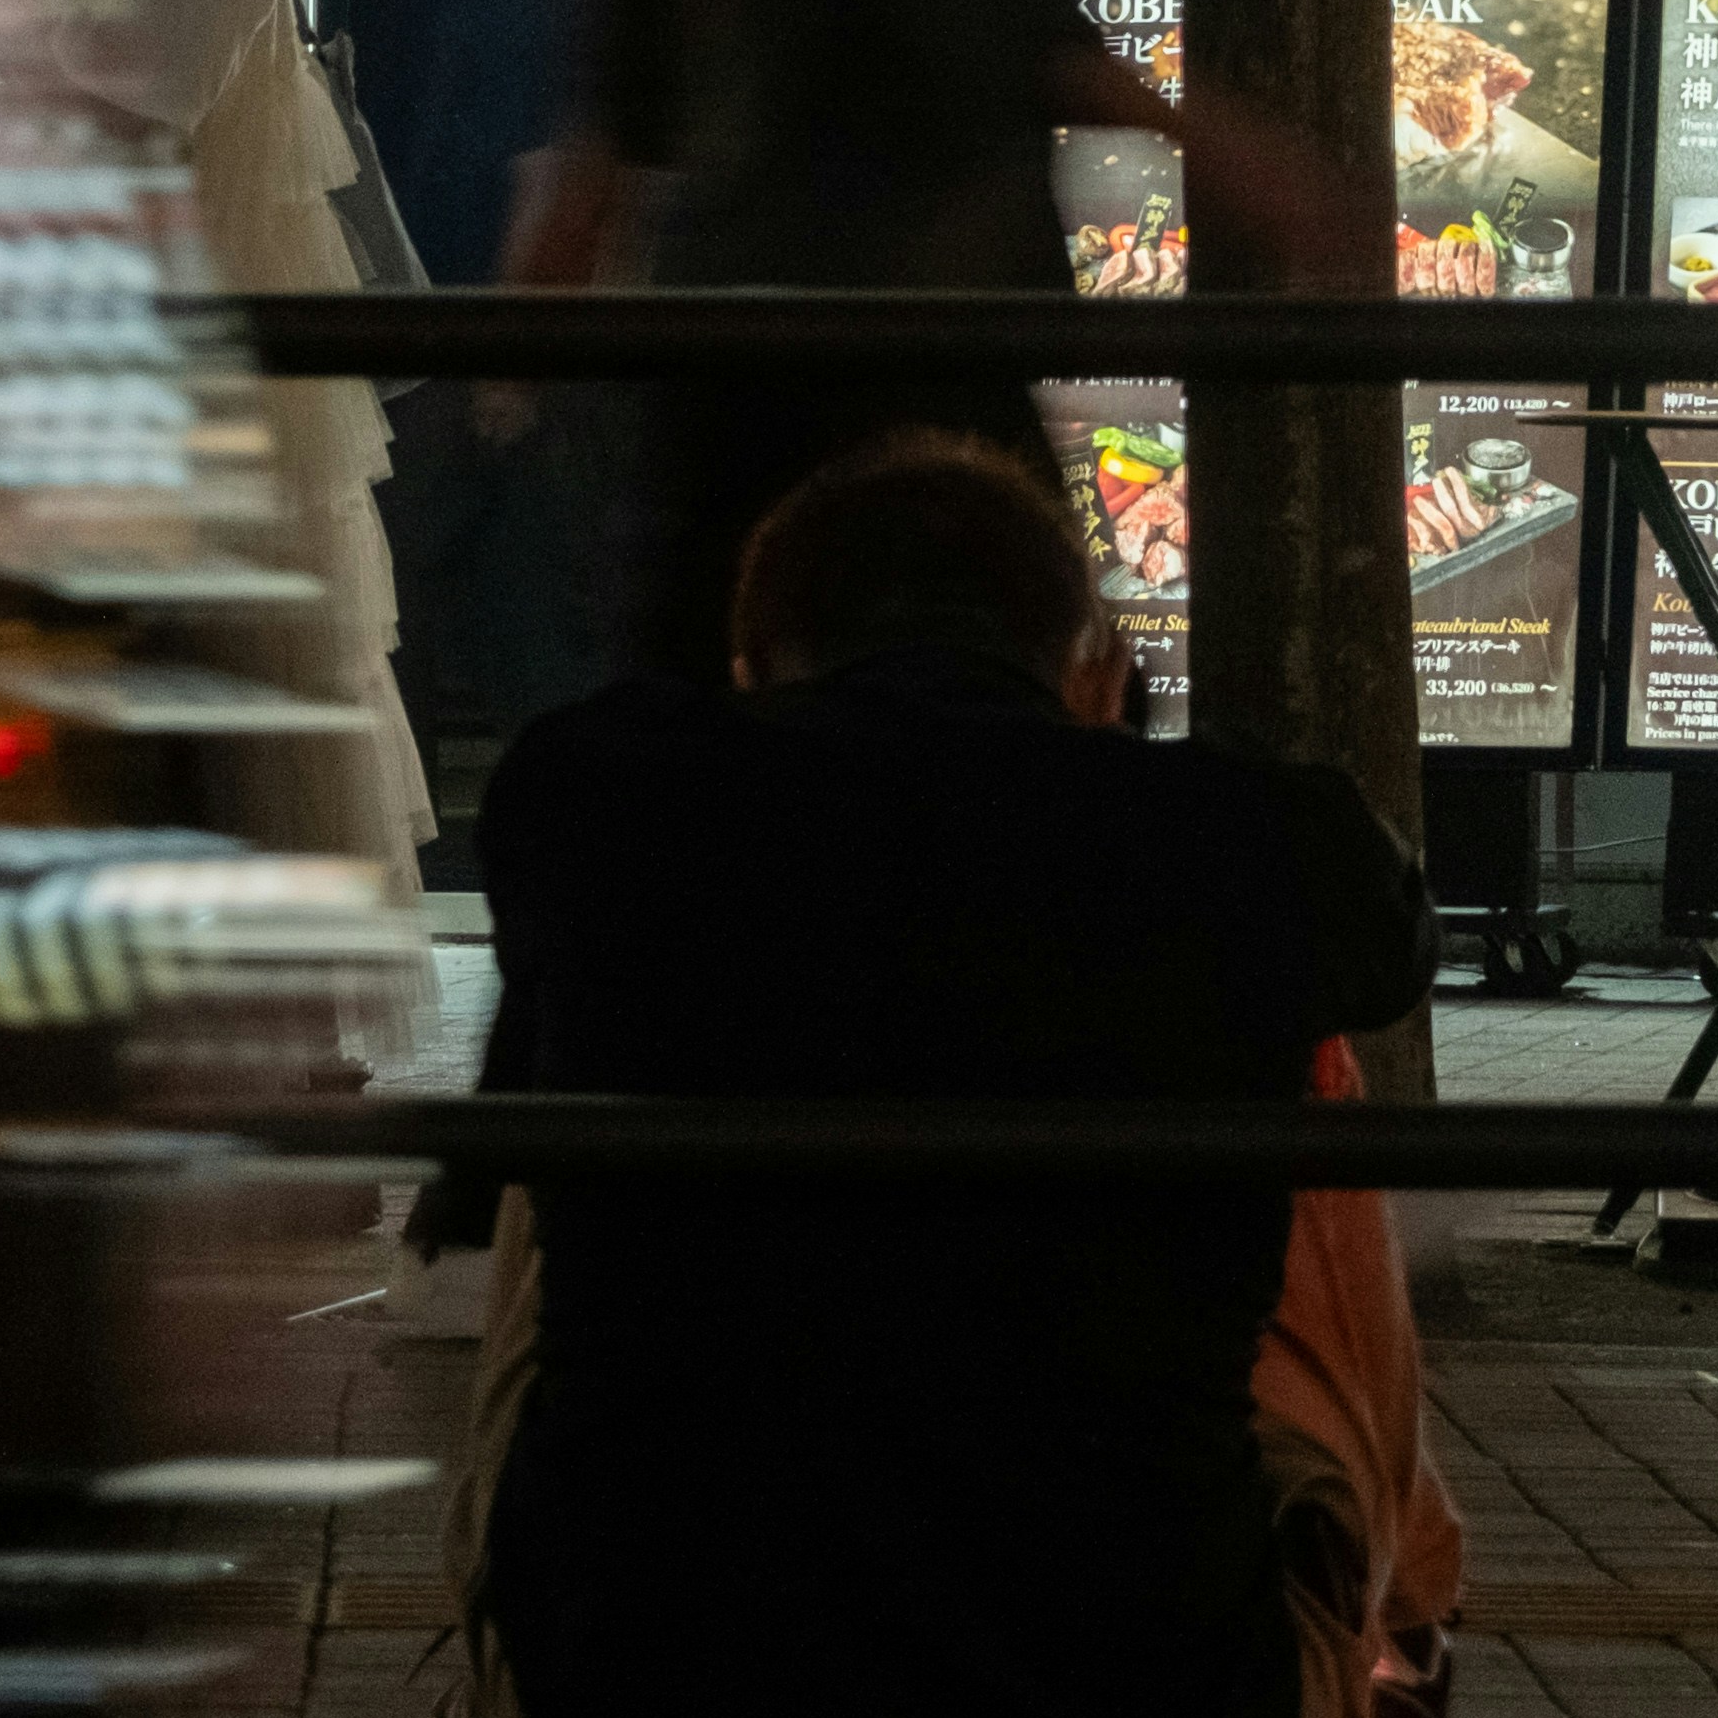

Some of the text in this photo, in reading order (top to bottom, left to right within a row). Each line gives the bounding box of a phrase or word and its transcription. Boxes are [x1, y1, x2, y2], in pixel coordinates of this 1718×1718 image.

[1439, 396, 1498, 415] 12,200
[1652, 593, 1692, 613] Ko
[1116, 613, 1190, 632] Fillet Ste
[1412, 618, 1551, 635] ateaubriand Steak
[1132, 636, 1174, 653] テーキ
[1414, 638, 1522, 655] ブリアンステーキ
[1148, 676, 1190, 696] 27,2
[1425, 679, 1487, 698] 33,200
[1646, 688, 1689, 700] Service
[1644, 727, 1682, 739] Prices
[1684, 728, 1695, 739] in
